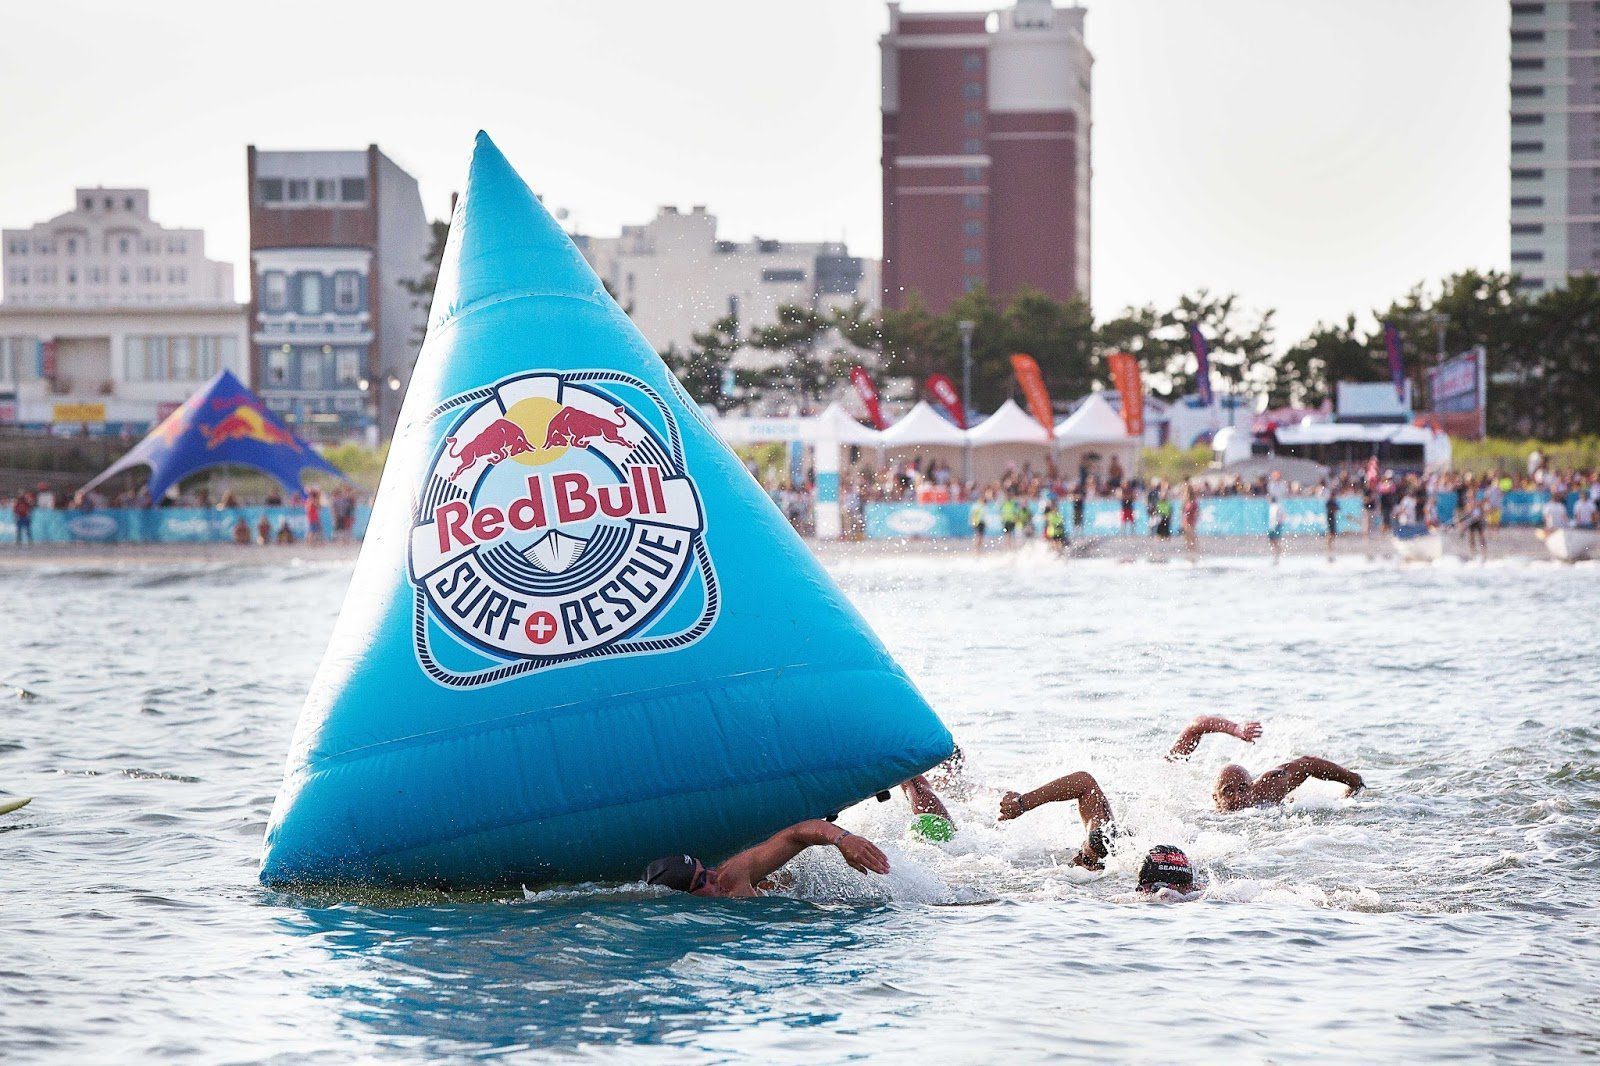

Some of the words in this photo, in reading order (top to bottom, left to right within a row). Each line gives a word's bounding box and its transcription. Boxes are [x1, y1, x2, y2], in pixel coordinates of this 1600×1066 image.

[435, 475, 547, 554] Red
[552, 466, 667, 524] Bull
[435, 561, 528, 641] SURF
[559, 529, 682, 645] RESCUE
